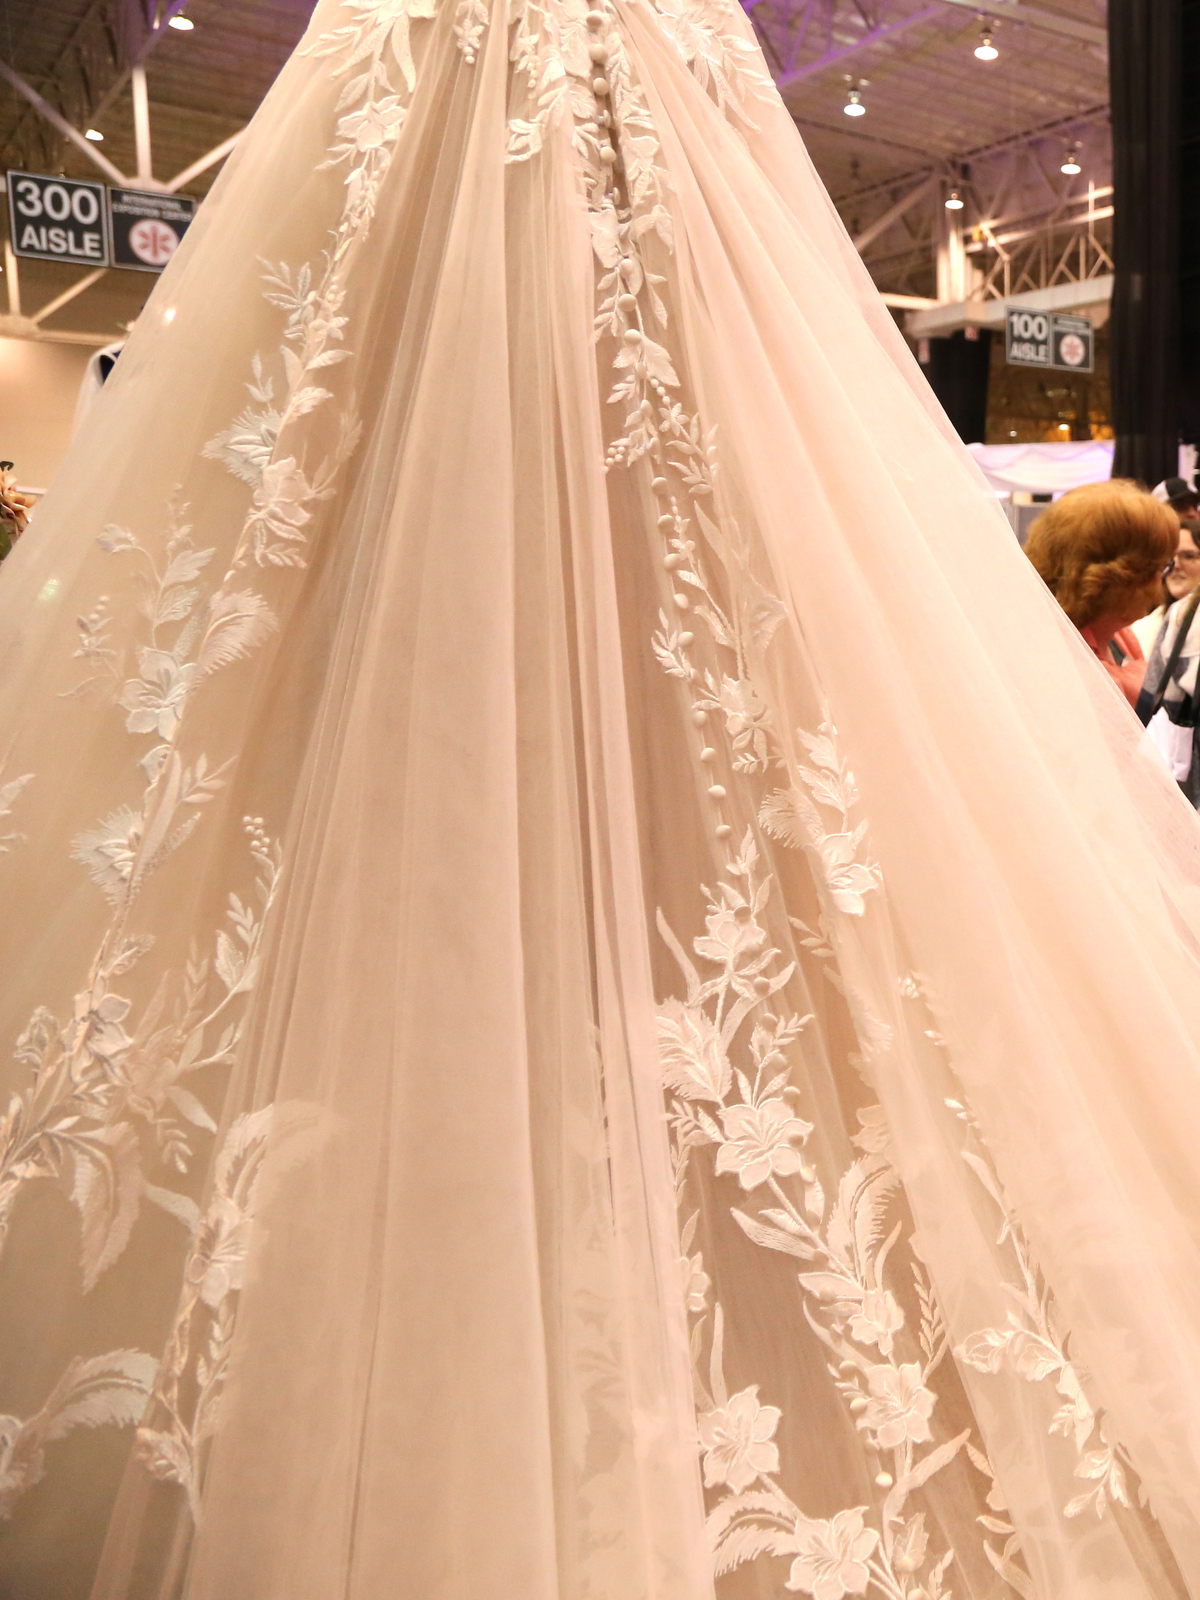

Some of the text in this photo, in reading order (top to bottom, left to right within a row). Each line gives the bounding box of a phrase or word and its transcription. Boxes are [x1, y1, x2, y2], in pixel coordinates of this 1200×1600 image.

[16, 179, 99, 226] 300
[20, 223, 102, 258] AISLE
[1009, 313, 1048, 341] 100
[1009, 341, 1048, 363] AISLE
